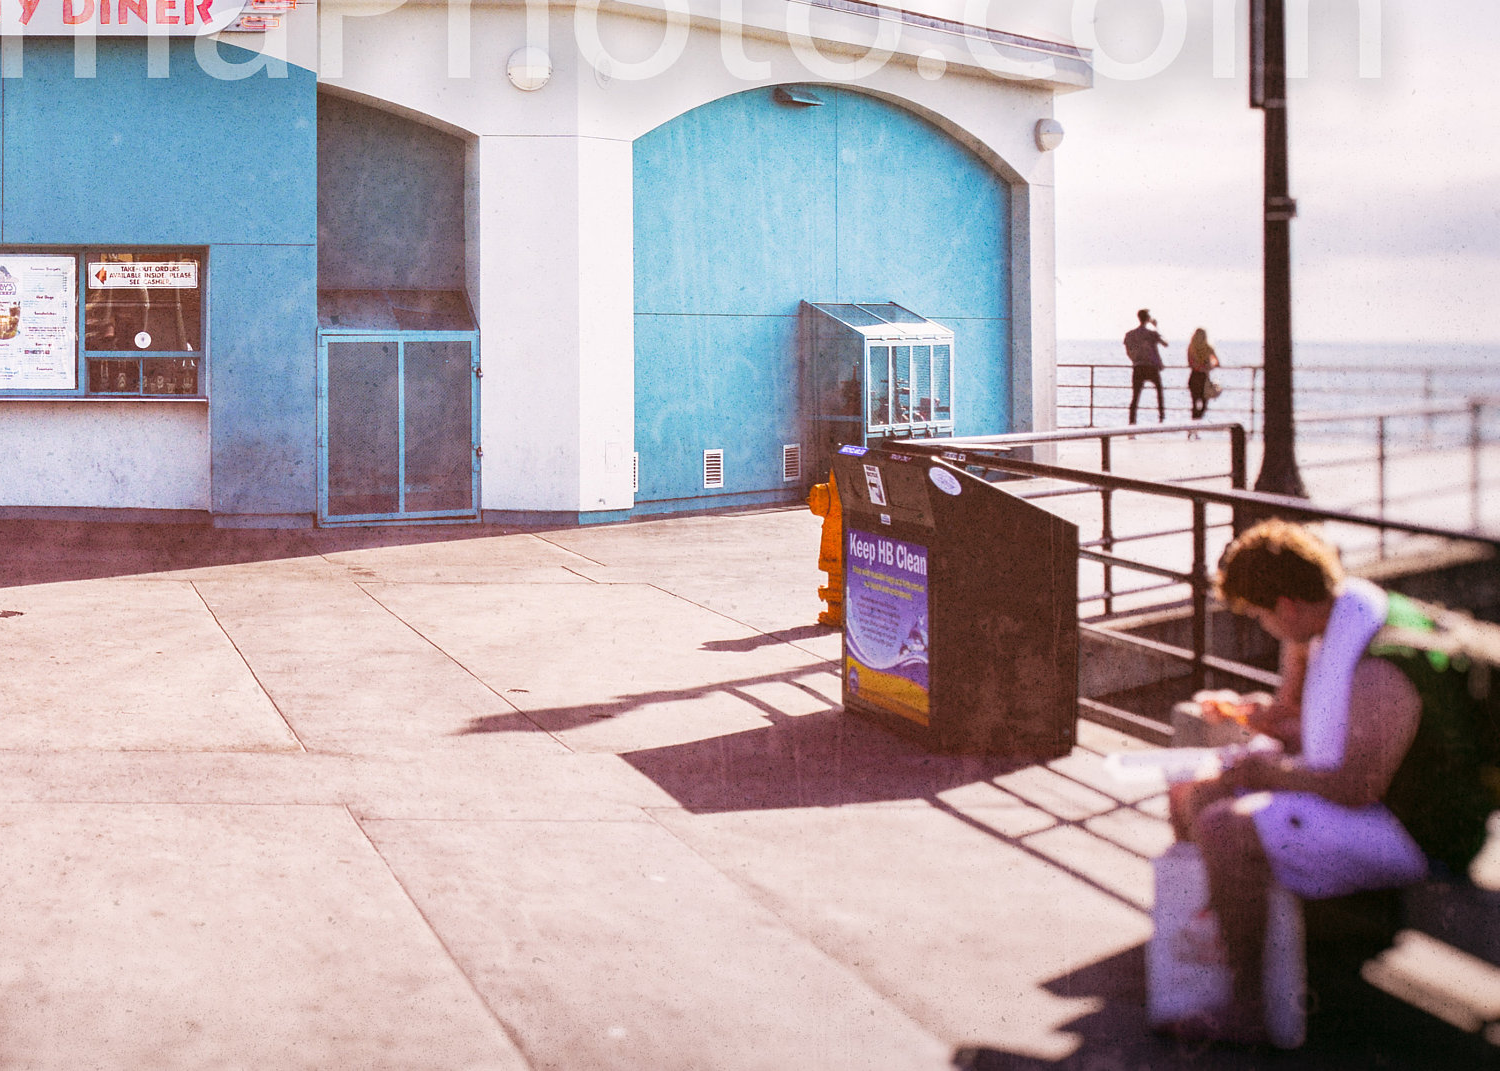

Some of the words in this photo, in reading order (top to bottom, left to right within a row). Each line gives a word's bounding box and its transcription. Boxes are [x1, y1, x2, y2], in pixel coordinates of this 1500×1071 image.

[849, 532, 876, 566] Keep
[878, 539, 894, 566] HB
[896, 544, 928, 576] Clean
